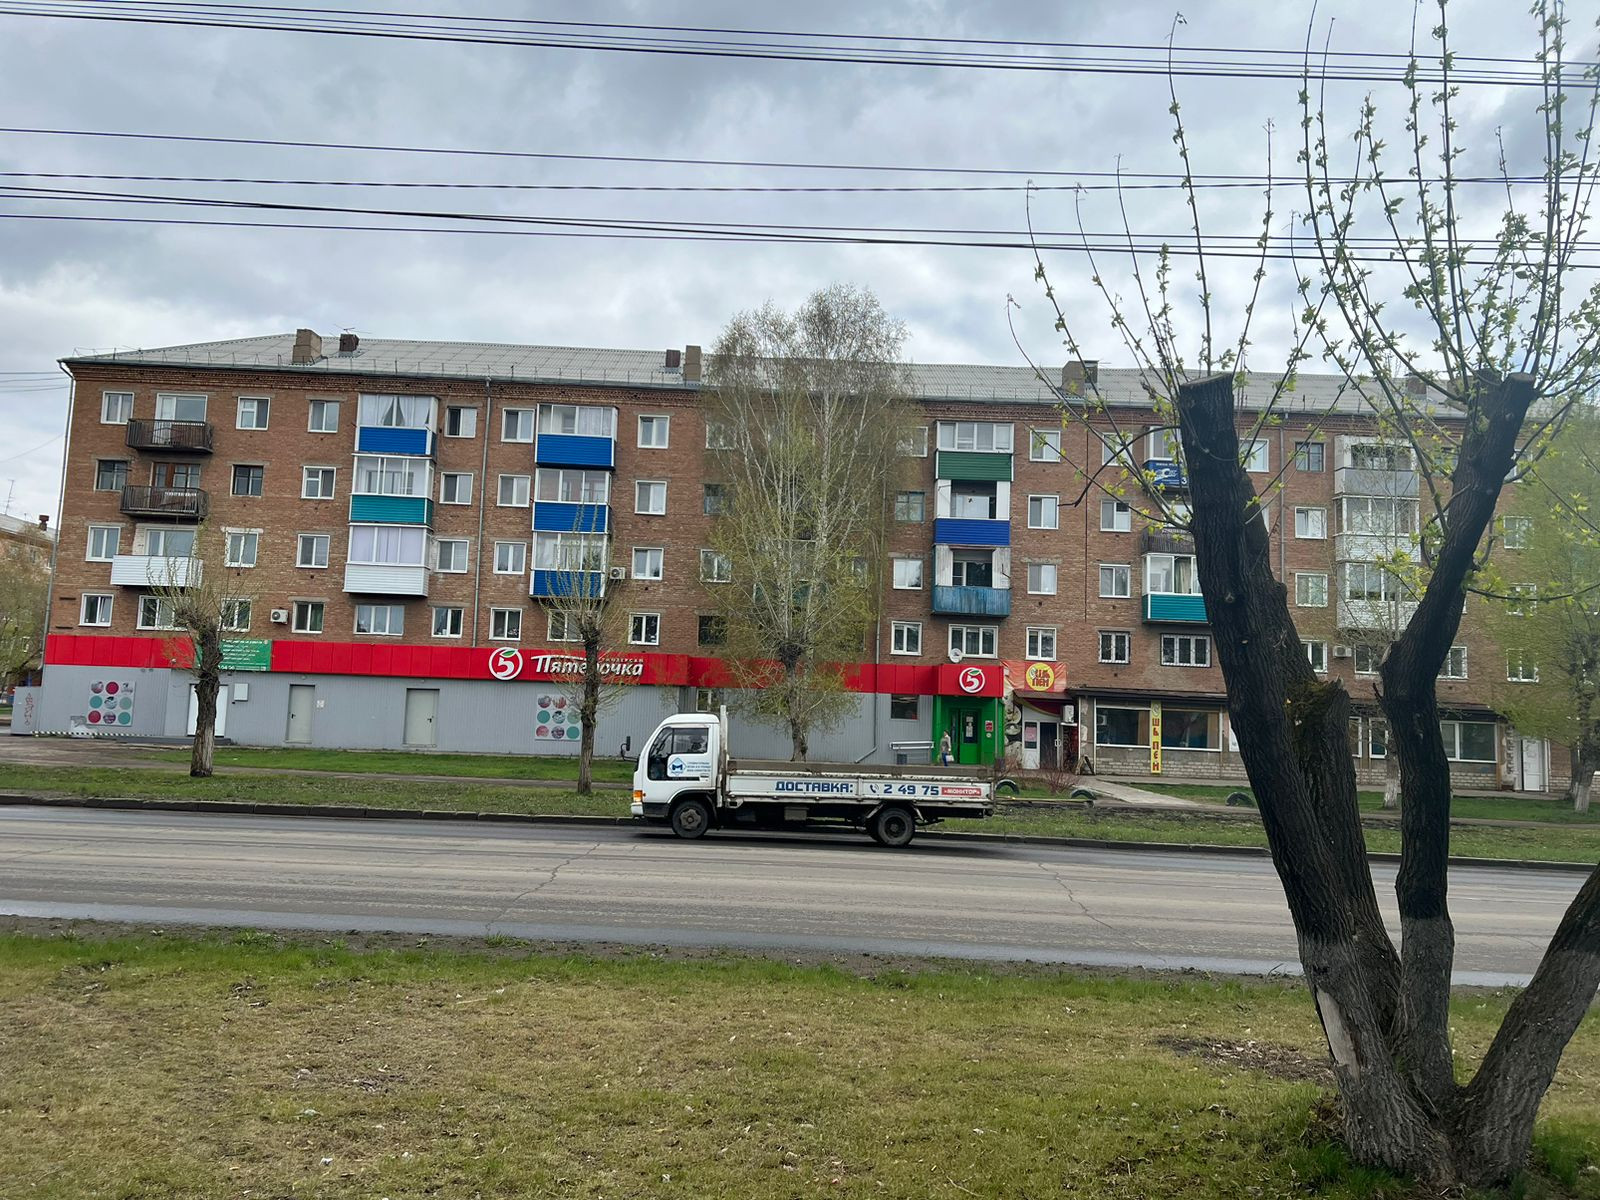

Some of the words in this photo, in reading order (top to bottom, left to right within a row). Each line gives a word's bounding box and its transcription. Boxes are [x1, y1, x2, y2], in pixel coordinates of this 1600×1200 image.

[775, 781, 853, 793] ДОСТАВКА:
[883, 784, 893, 794] 2
[898, 785, 916, 795] 49
[921, 785, 939, 796] 75
